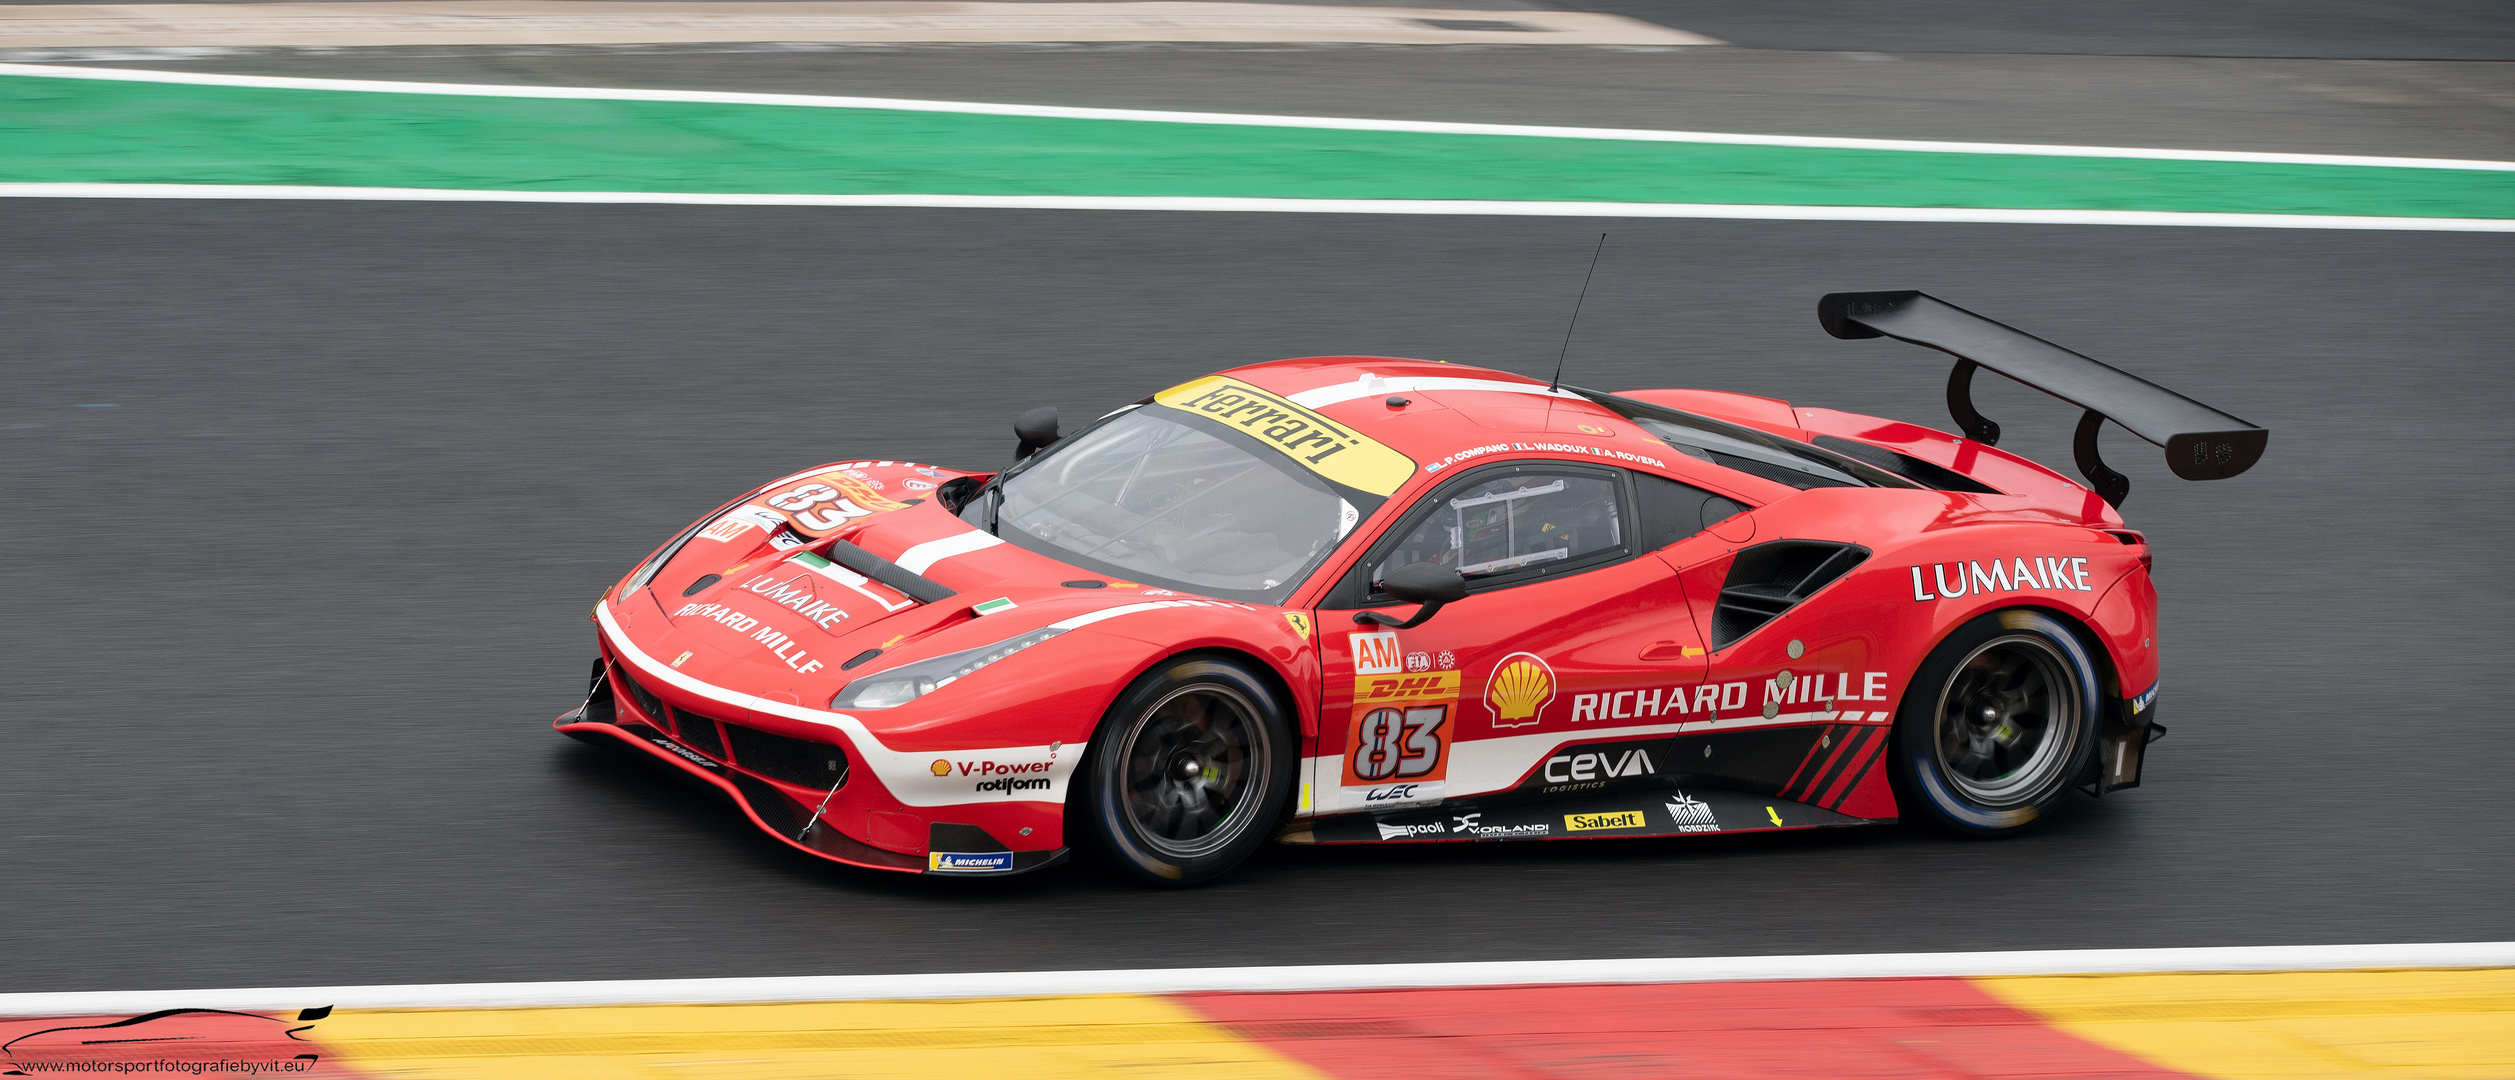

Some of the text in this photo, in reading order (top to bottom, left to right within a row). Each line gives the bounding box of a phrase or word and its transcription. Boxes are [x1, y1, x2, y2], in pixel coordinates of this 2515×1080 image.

[1181, 385, 1360, 465] Ferrari
[765, 482, 880, 532] 83
[701, 520, 749, 539] AM
[1910, 556, 2093, 602] LUMAIKE
[739, 575, 850, 630] LUMAIKE
[673, 603, 824, 674] RICHARD MILLE
[1358, 637, 1399, 668] AM
[1407, 655, 1429, 668] FIA
[1366, 676, 1442, 698] DHL
[1571, 671, 1888, 722] RICHARD MILLE
[1353, 704, 1447, 781] 83
[957, 761, 1053, 777] V-Power
[976, 777, 1050, 795] rotiform
[1366, 784, 1419, 801] WEC
[1543, 781, 1605, 793] LOGISTICS
[1407, 821, 1445, 837] paoli
[1573, 812, 1637, 829] Sabelt
[955, 857, 1004, 866] MICHELIN
